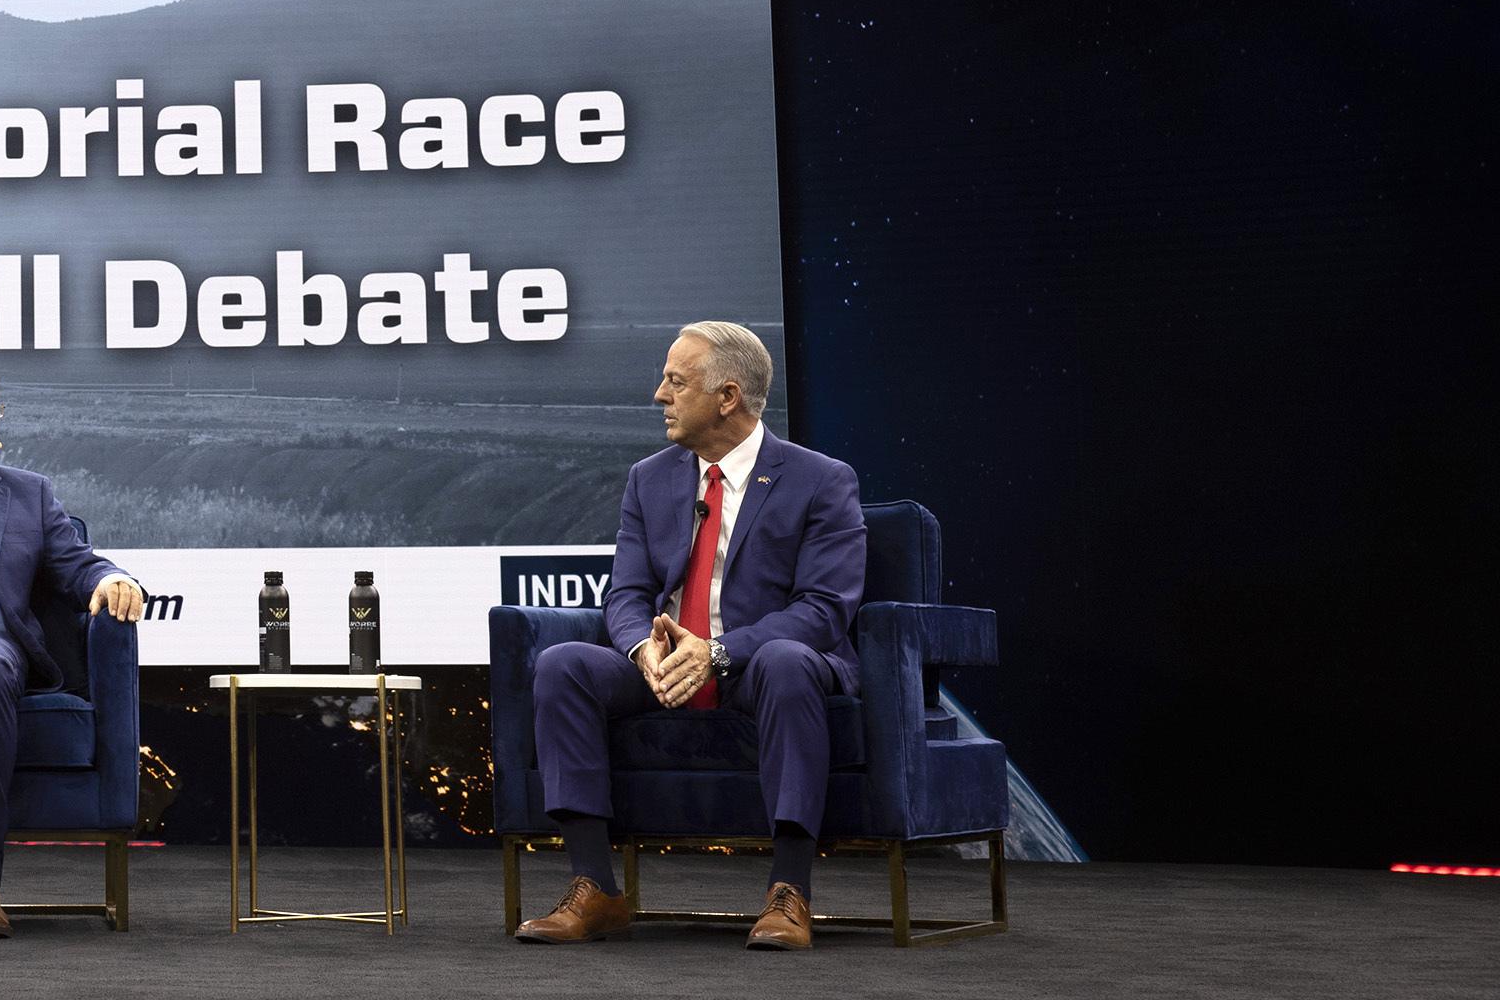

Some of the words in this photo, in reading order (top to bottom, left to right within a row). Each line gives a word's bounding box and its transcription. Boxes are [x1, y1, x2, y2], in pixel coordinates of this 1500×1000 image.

[306, 83, 625, 172] Race
[105, 250, 569, 349] Debate
[518, 574, 610, 607] INDY
